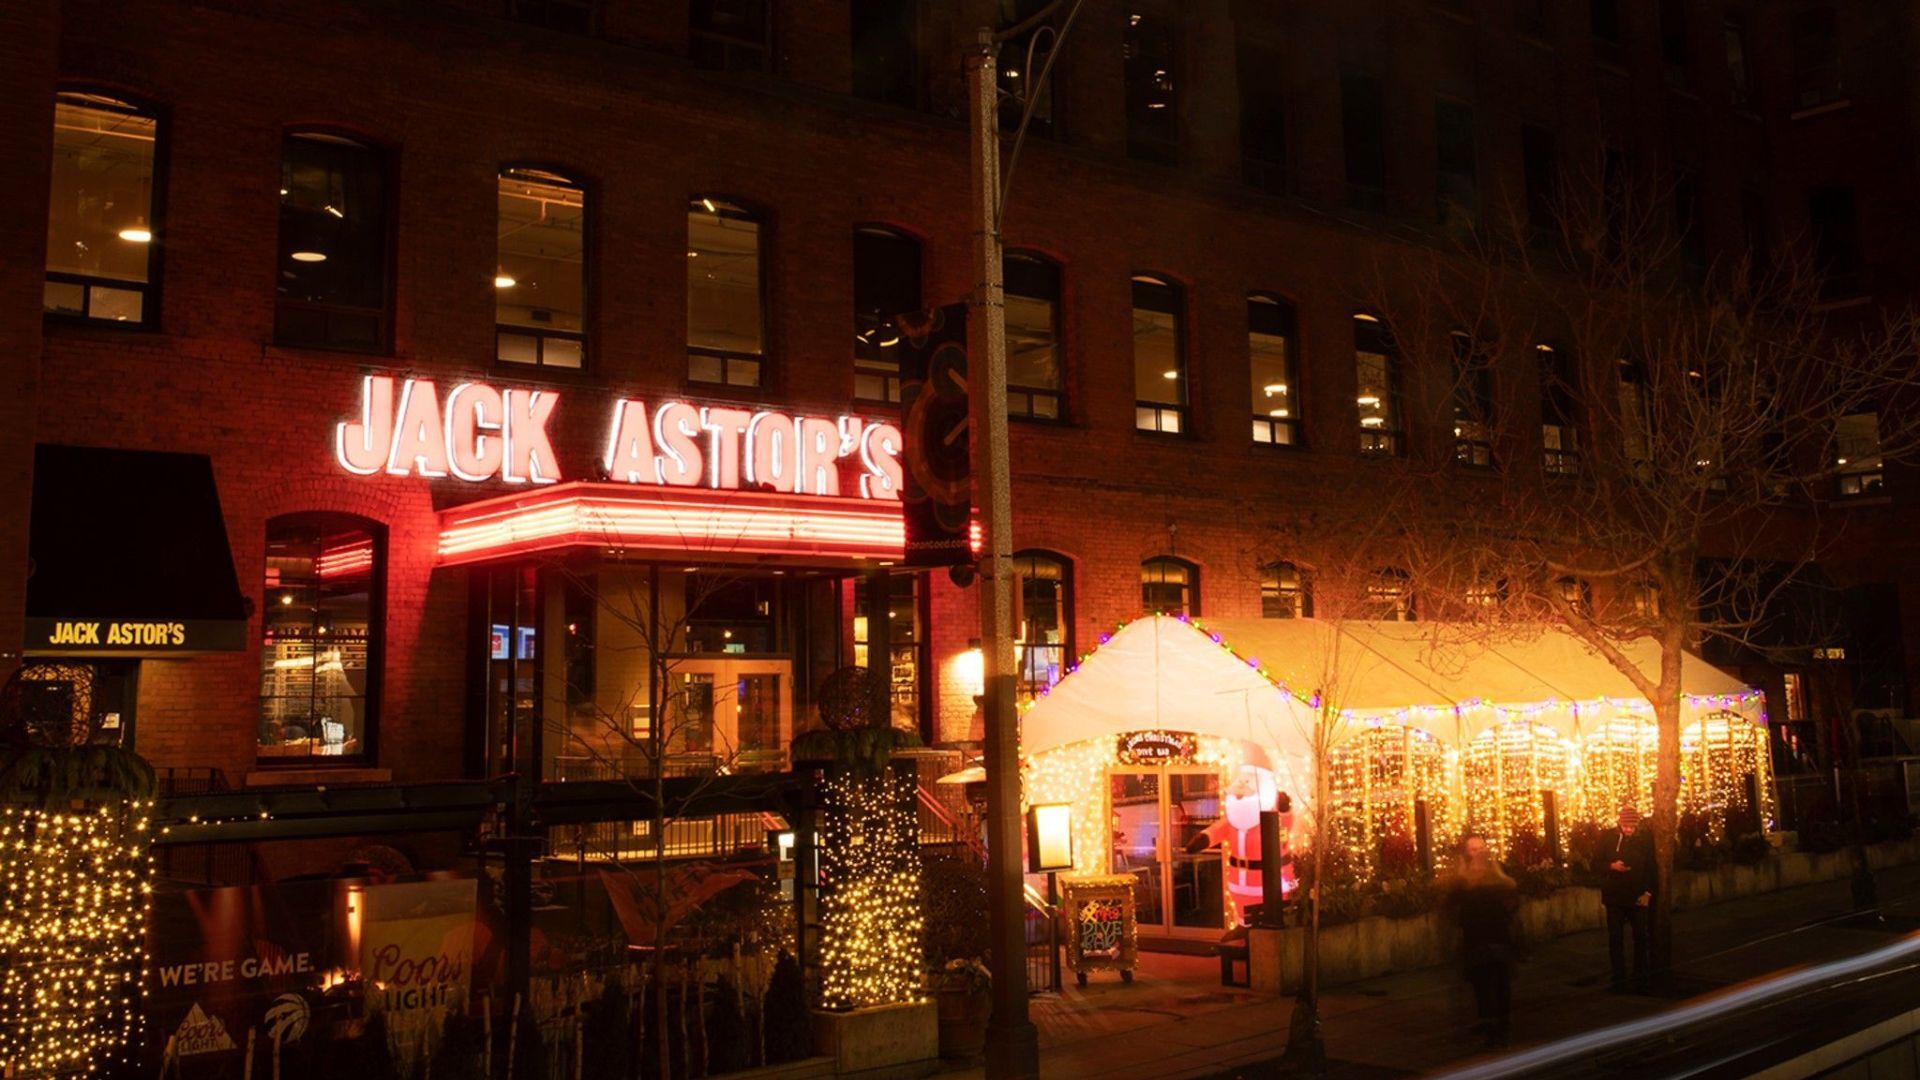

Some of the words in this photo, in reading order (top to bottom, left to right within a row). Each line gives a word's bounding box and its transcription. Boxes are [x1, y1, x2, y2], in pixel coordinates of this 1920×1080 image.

[337, 374, 562, 484] JACK
[604, 398, 904, 500] ASTOR'S
[49, 621, 100, 645] JACK
[106, 622, 185, 645] ASTOR'S
[1081, 920, 1123, 936] DIVE
[159, 959, 236, 989] WE'RE
[240, 951, 316, 979] GAME.
[372, 943, 464, 986] Coors
